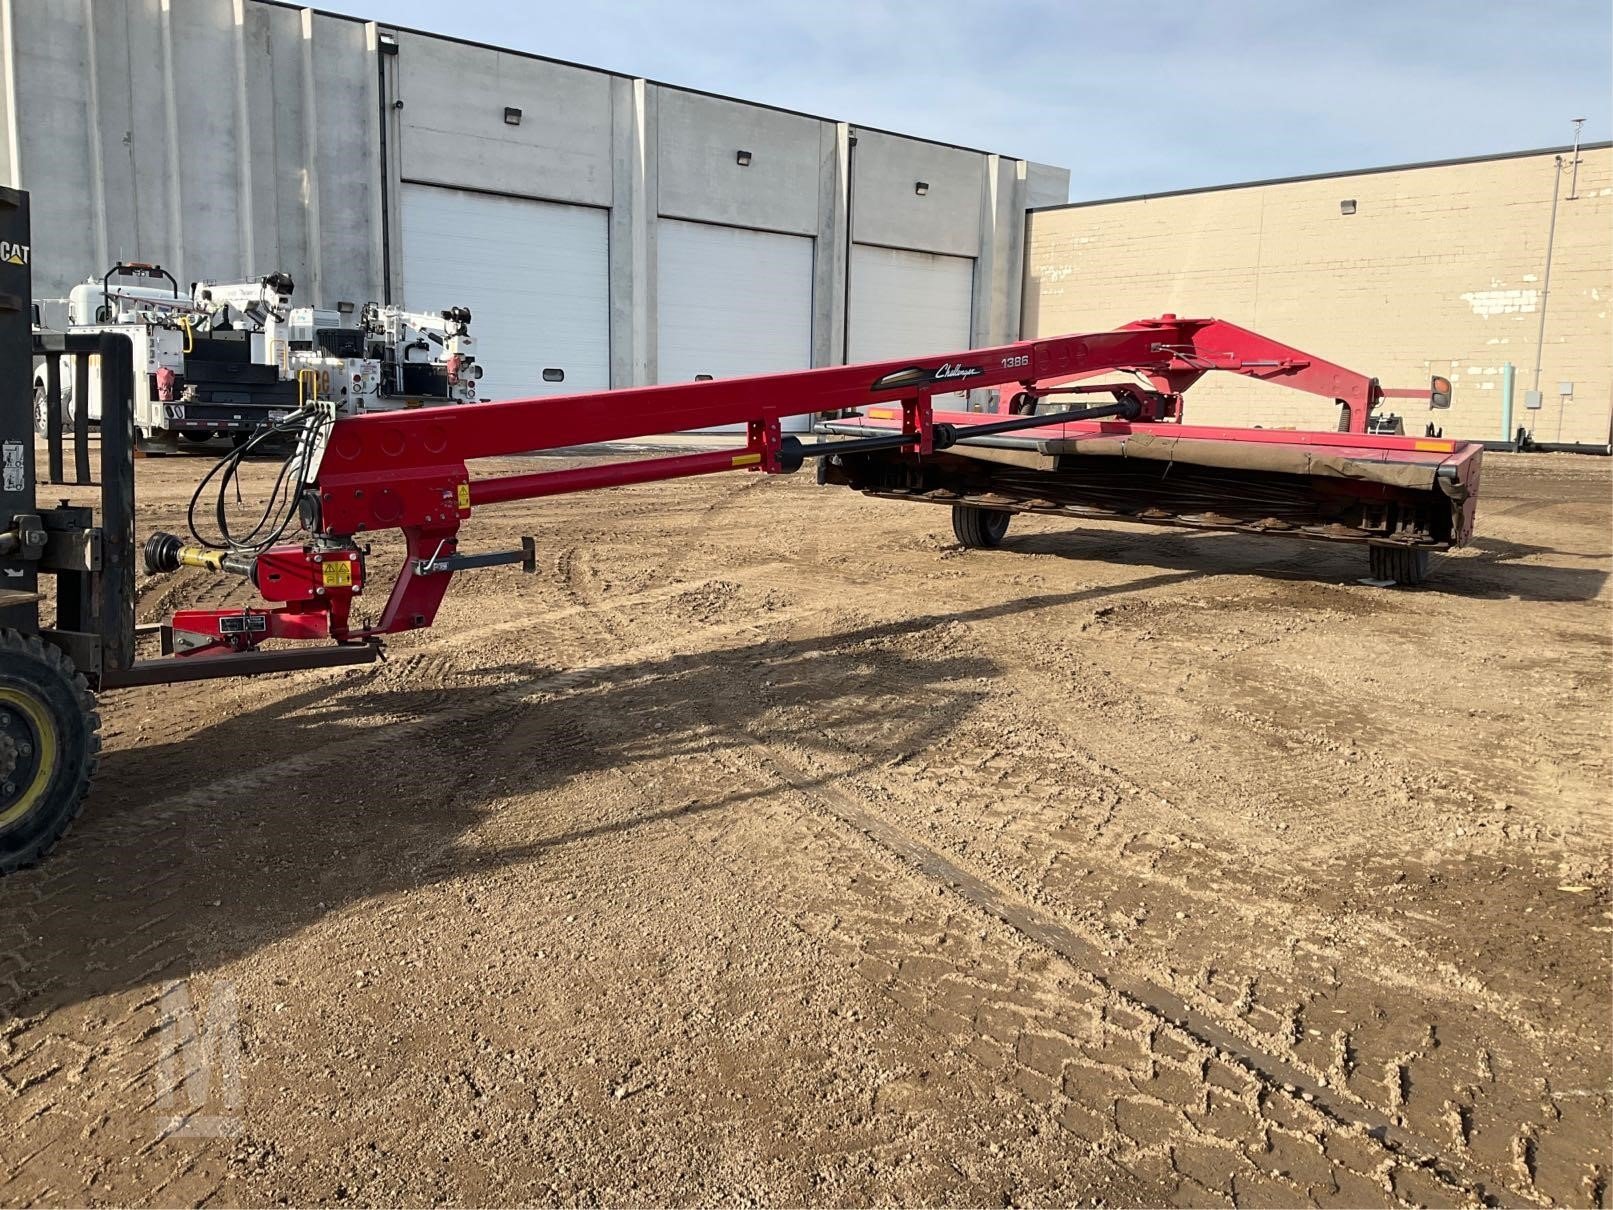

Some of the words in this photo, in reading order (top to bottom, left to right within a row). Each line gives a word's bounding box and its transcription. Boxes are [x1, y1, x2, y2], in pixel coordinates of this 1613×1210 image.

[0, 241, 30, 264] CAT
[1001, 355, 1029, 369] 1386
[935, 363, 980, 380] Challenger
